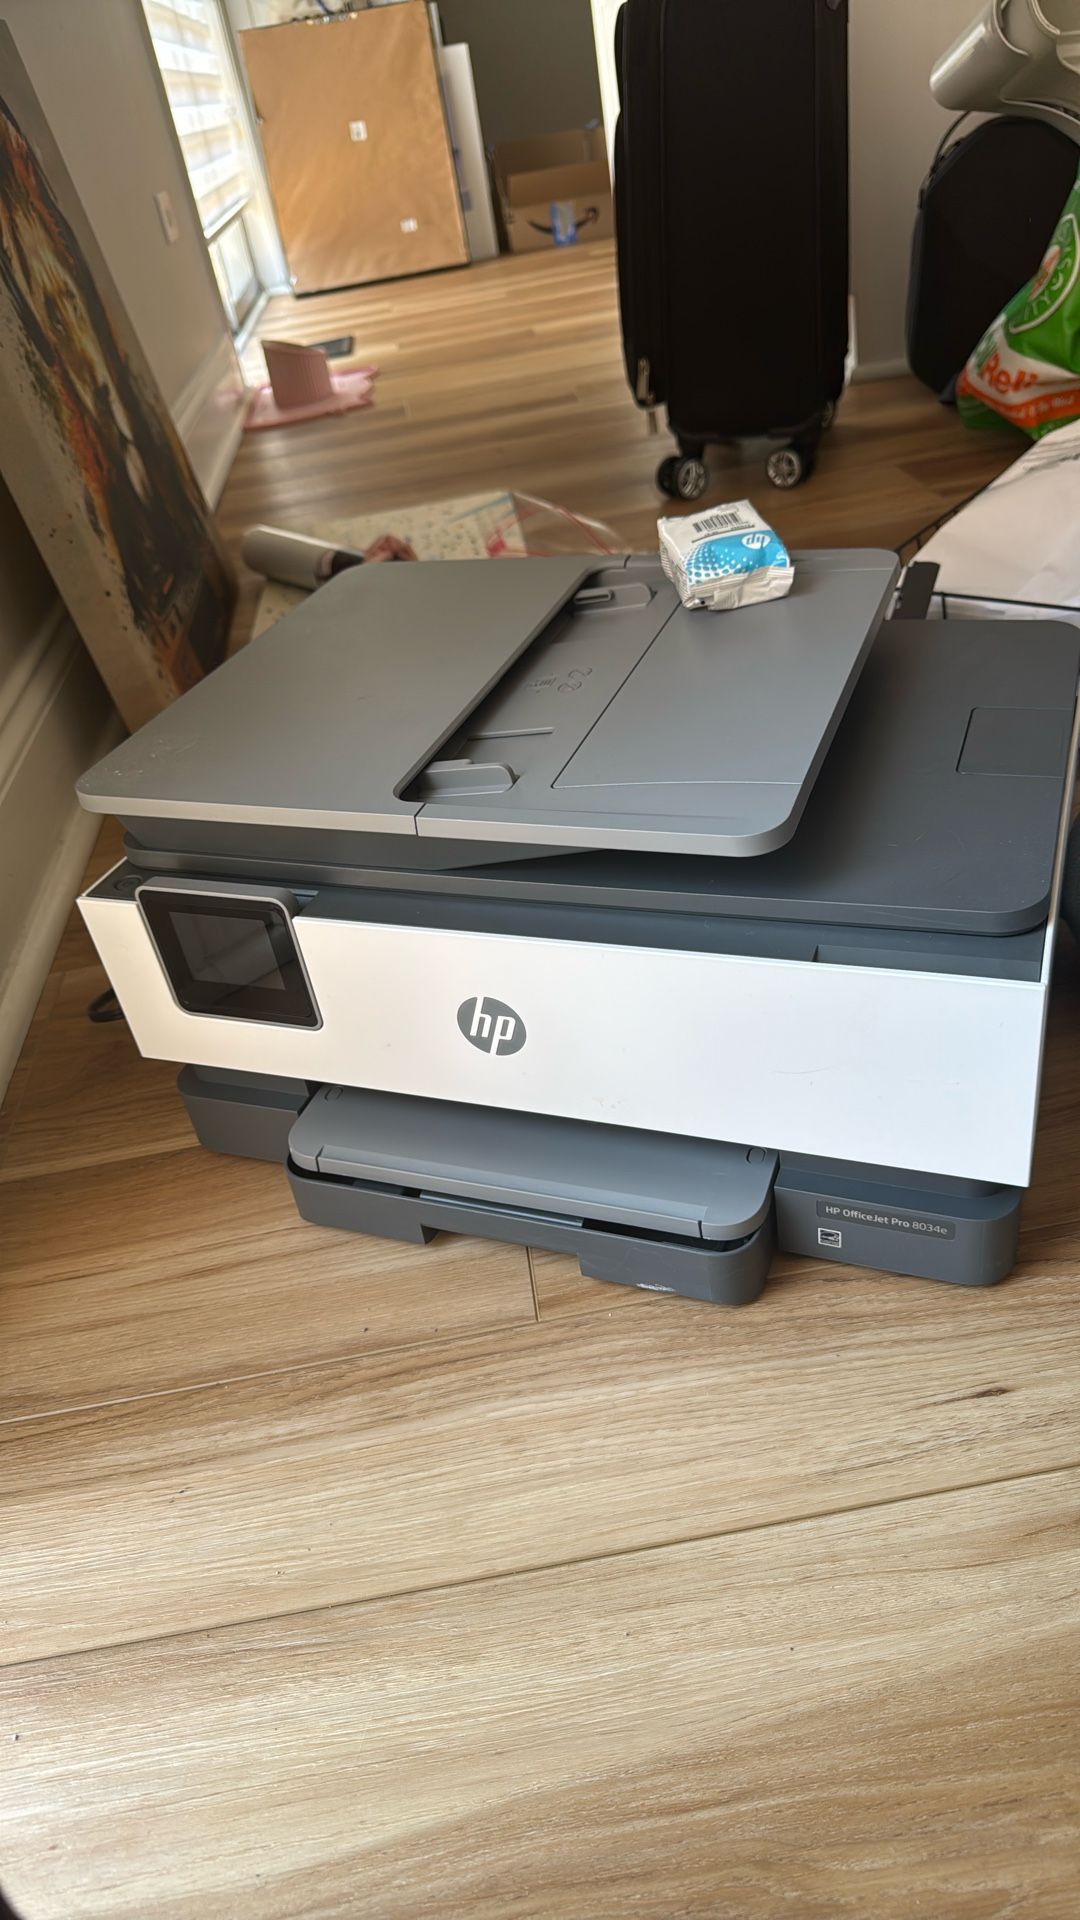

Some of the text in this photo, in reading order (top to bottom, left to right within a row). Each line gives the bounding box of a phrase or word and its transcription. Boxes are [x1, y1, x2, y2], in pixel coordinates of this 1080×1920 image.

[743, 533, 768, 549] hp
[469, 996, 516, 1055] hp
[825, 1206, 948, 1235] HP OfficeJet Pro 8034e
